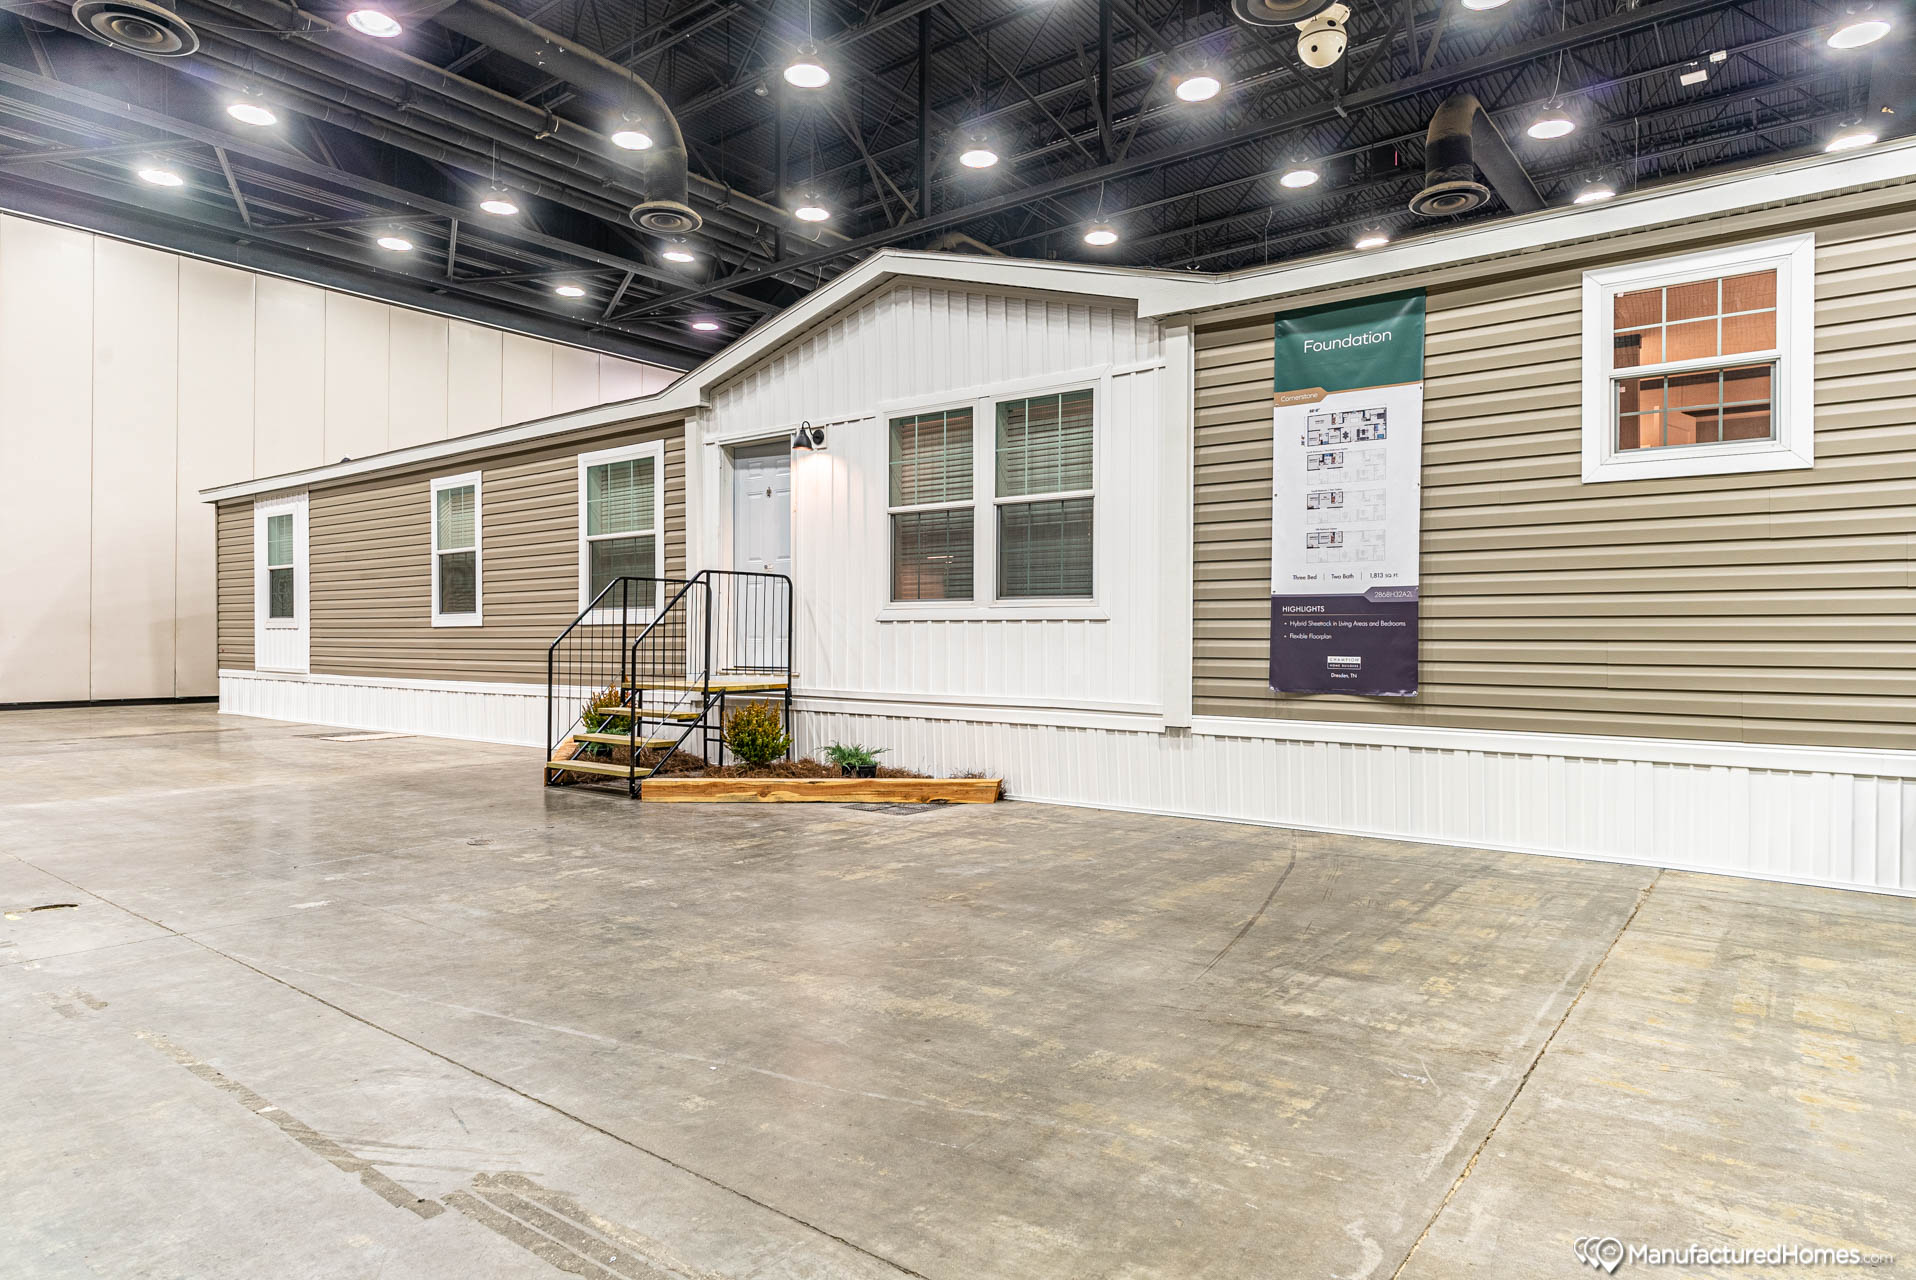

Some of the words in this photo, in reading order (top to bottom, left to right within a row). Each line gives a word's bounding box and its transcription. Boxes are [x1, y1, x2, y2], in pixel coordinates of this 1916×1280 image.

[1303, 330, 1392, 353] Foundation
[1280, 392, 1319, 402] Cornerstone
[1282, 605, 1325, 613] HIGHLIGHTS
[1289, 620, 1307, 628] Hybrid
[1338, 620, 1352, 628] Living
[1308, 632, 1332, 641] Floorplan
